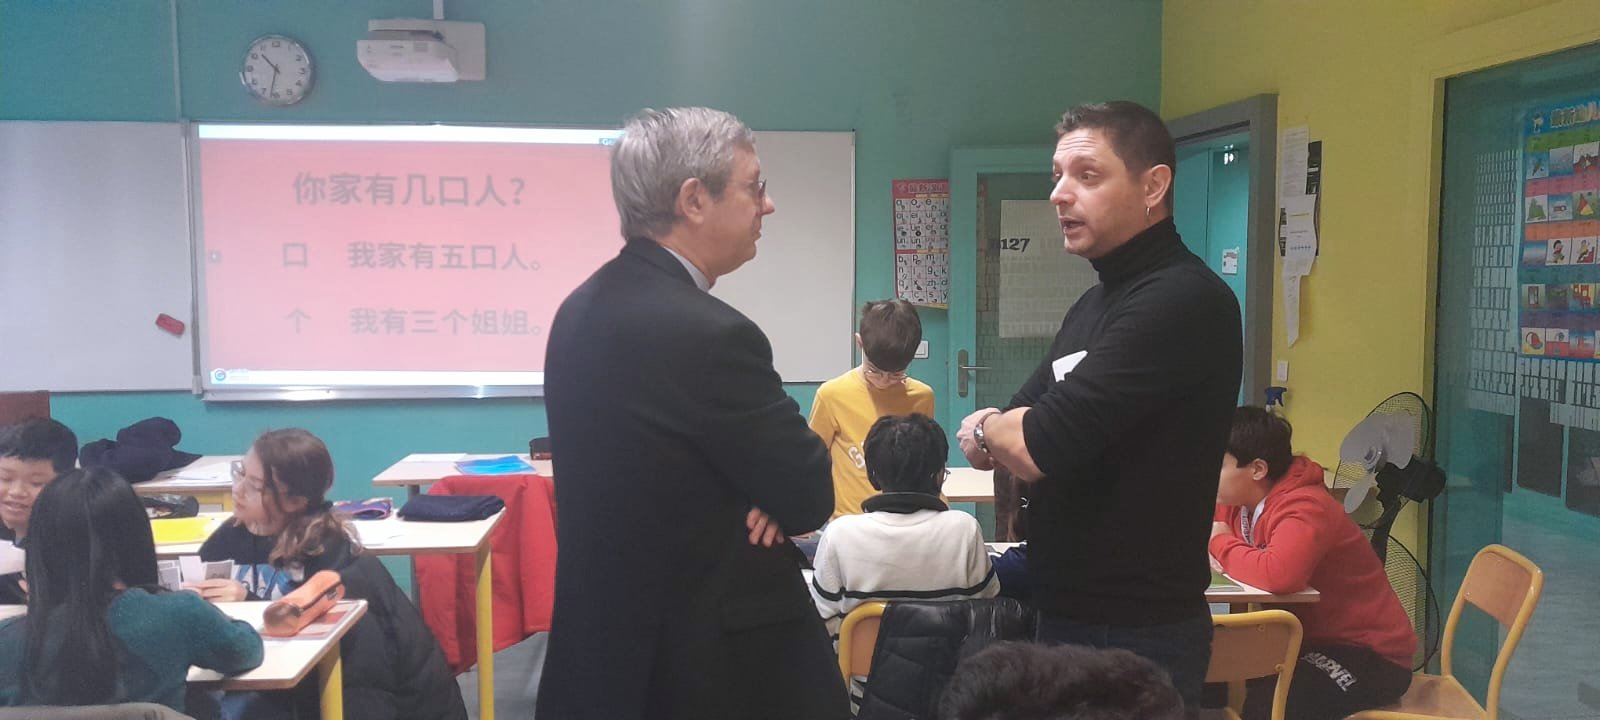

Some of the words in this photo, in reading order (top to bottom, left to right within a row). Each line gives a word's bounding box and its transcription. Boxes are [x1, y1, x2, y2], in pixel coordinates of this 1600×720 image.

[293, 172, 526, 207] 你家有几口人？
[283, 242, 309, 268] 口
[347, 242, 543, 271] 我家有五口人。
[990, 238, 1031, 252] 127
[285, 309, 312, 335] 个
[351, 309, 543, 337] 我有三个姐姐。
